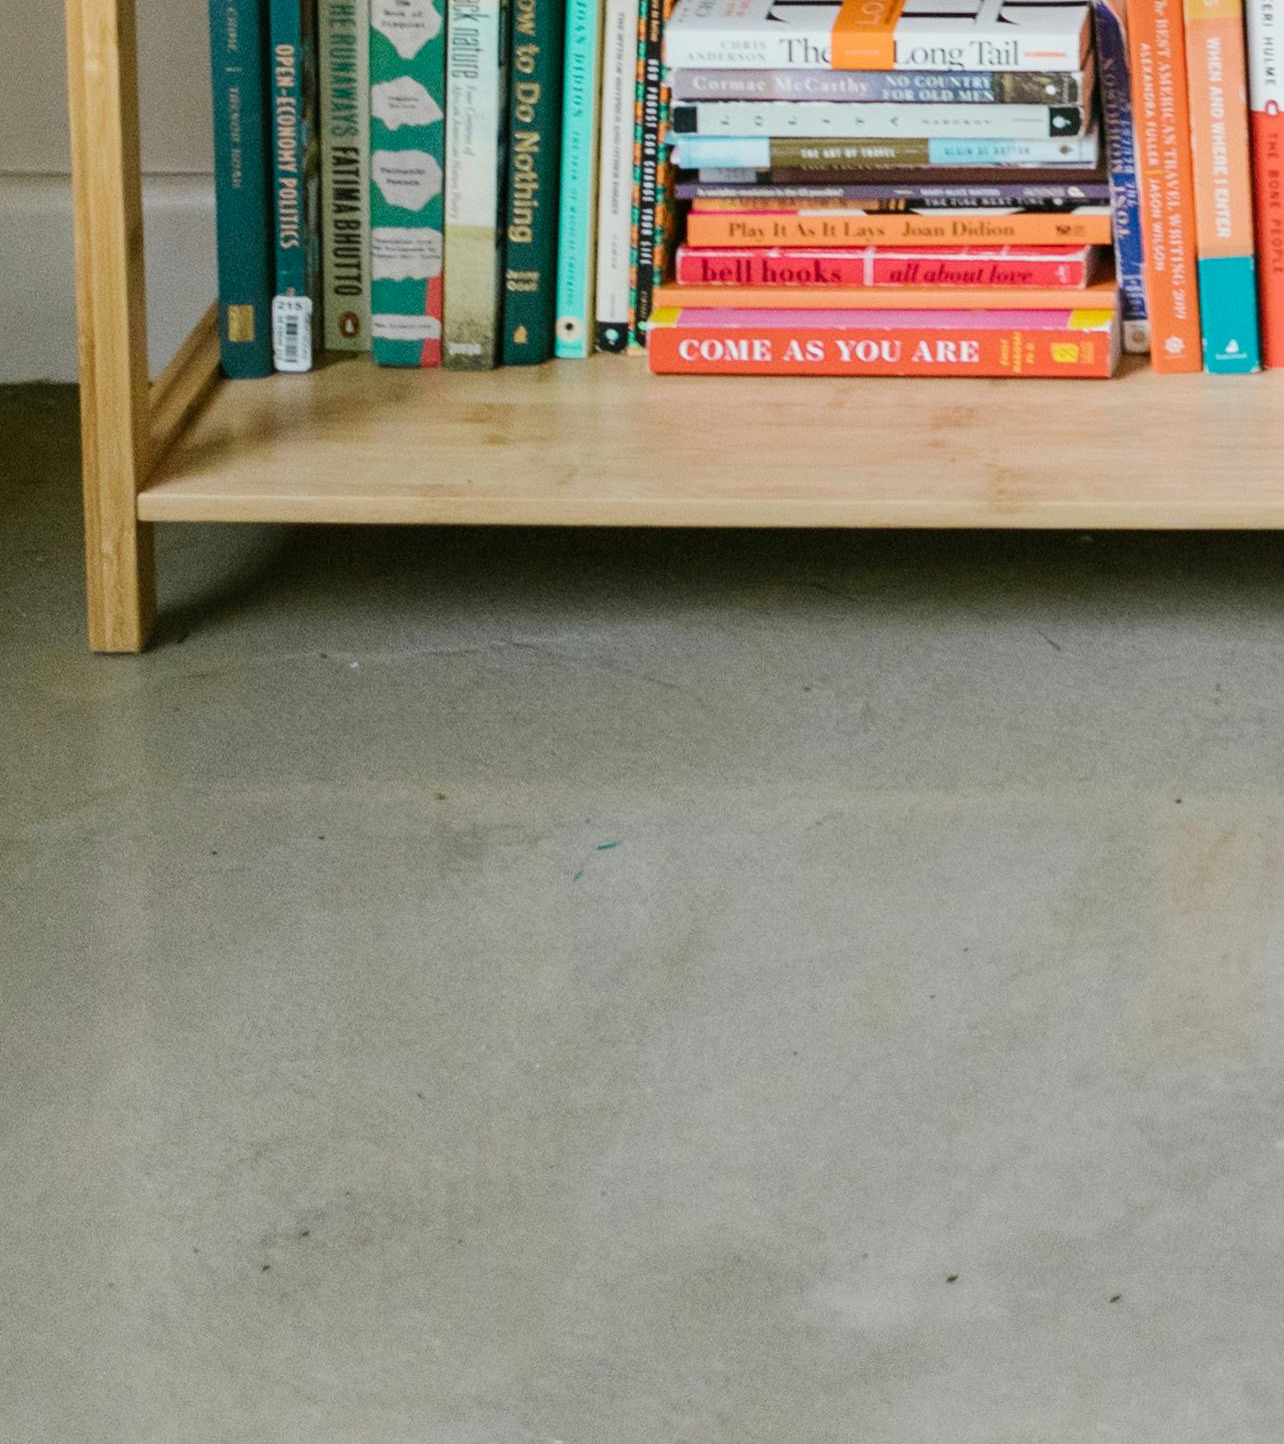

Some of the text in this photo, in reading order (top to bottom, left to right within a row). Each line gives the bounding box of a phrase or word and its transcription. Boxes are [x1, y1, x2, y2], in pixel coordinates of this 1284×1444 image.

[450, 28, 485, 79] nature
[513, 44, 540, 73] to
[894, 38, 1020, 68] Long Tail
[1261, 37, 1277, 87] HULME
[328, 32, 358, 137] RUNAWAYS
[514, 83, 540, 122] Do
[275, 44, 300, 248] OPEN-ECONOMY POLITICS
[1266, 133, 1279, 161] THE
[330, 146, 359, 215] FATIMA
[509, 131, 540, 244] Nothing
[1267, 170, 1281, 209] BONE
[333, 219, 363, 297] BHUTTO
[1269, 218, 1284, 275] PEOPLE
[701, 261, 1034, 284] bell hooks all about love
[678, 339, 980, 362] COME AS YOU ARE
